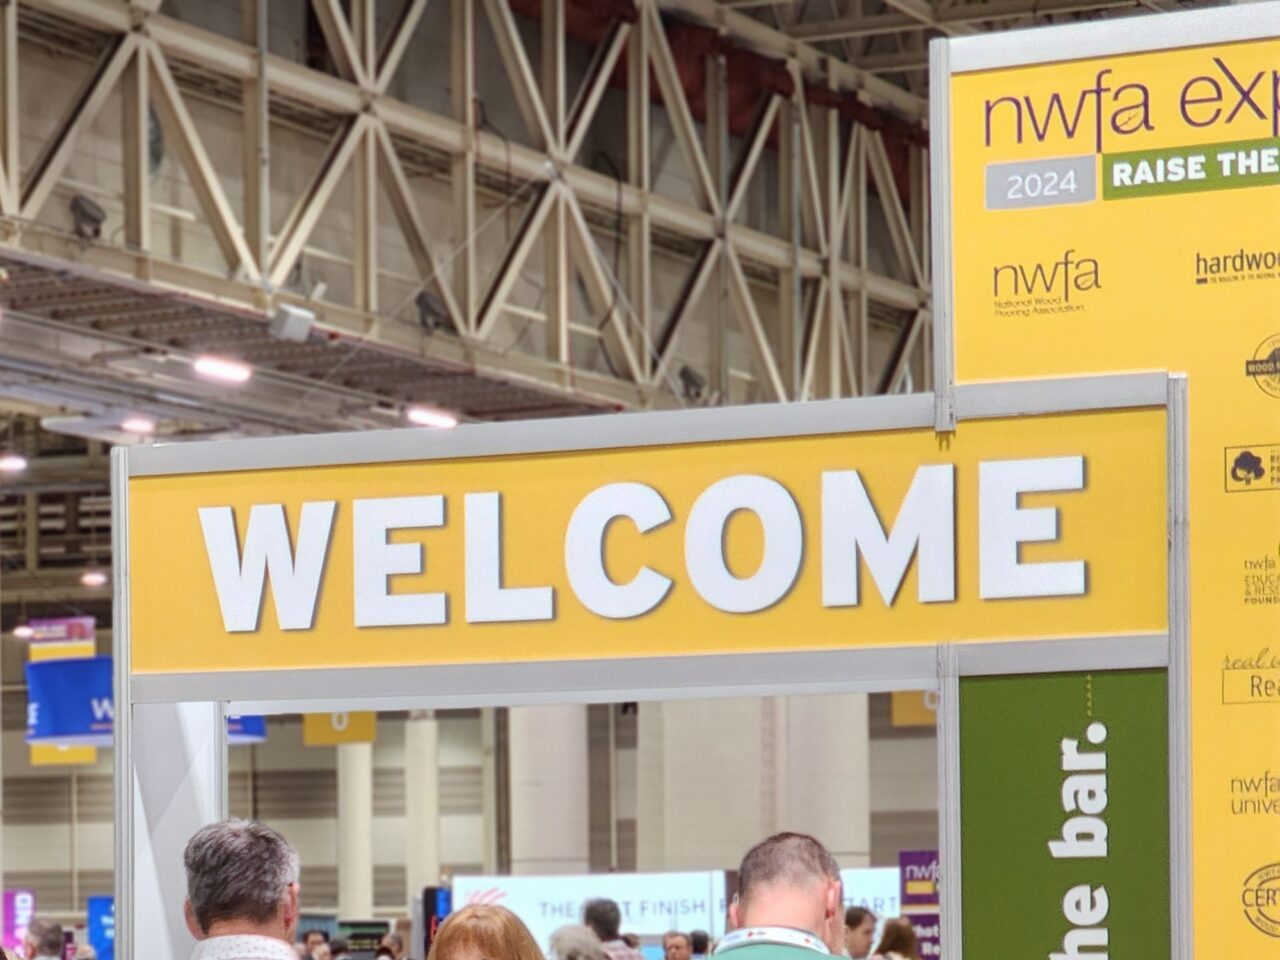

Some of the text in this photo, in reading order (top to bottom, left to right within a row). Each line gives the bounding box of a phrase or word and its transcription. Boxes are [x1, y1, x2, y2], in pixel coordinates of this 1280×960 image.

[984, 69, 1155, 154] nwfa
[1007, 148, 1280, 199] 2024 RAISE THE
[993, 249, 1102, 303] nwfa
[1196, 248, 1280, 275] hardwo
[197, 455, 1086, 634] WELCOME
[1250, 674, 1280, 698] Re
[1047, 721, 1109, 859] bar.
[540, 901, 572, 918] THE
[639, 899, 706, 916] FINISH
